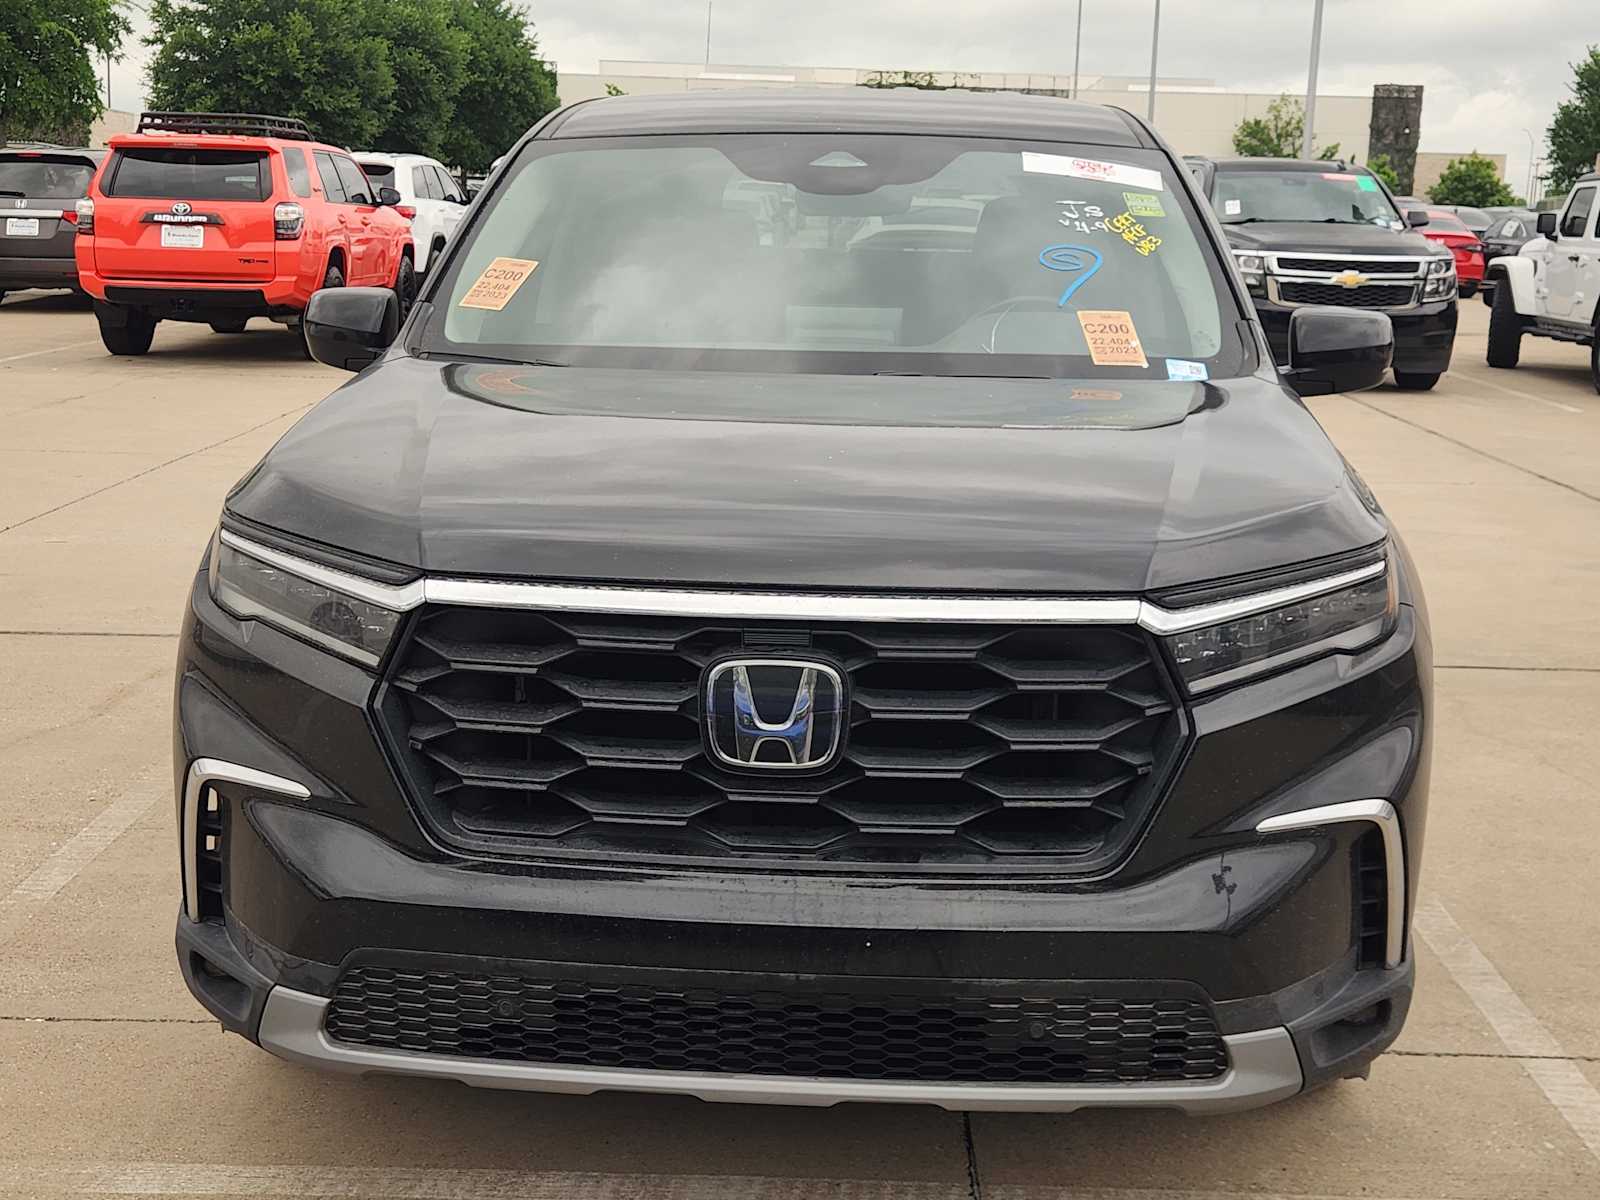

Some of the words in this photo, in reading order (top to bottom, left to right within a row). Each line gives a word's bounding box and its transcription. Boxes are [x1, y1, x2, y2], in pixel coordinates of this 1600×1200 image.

[485, 268, 524, 281] C200
[1083, 322, 1129, 334] C200
[1109, 346, 1138, 354] 2023
